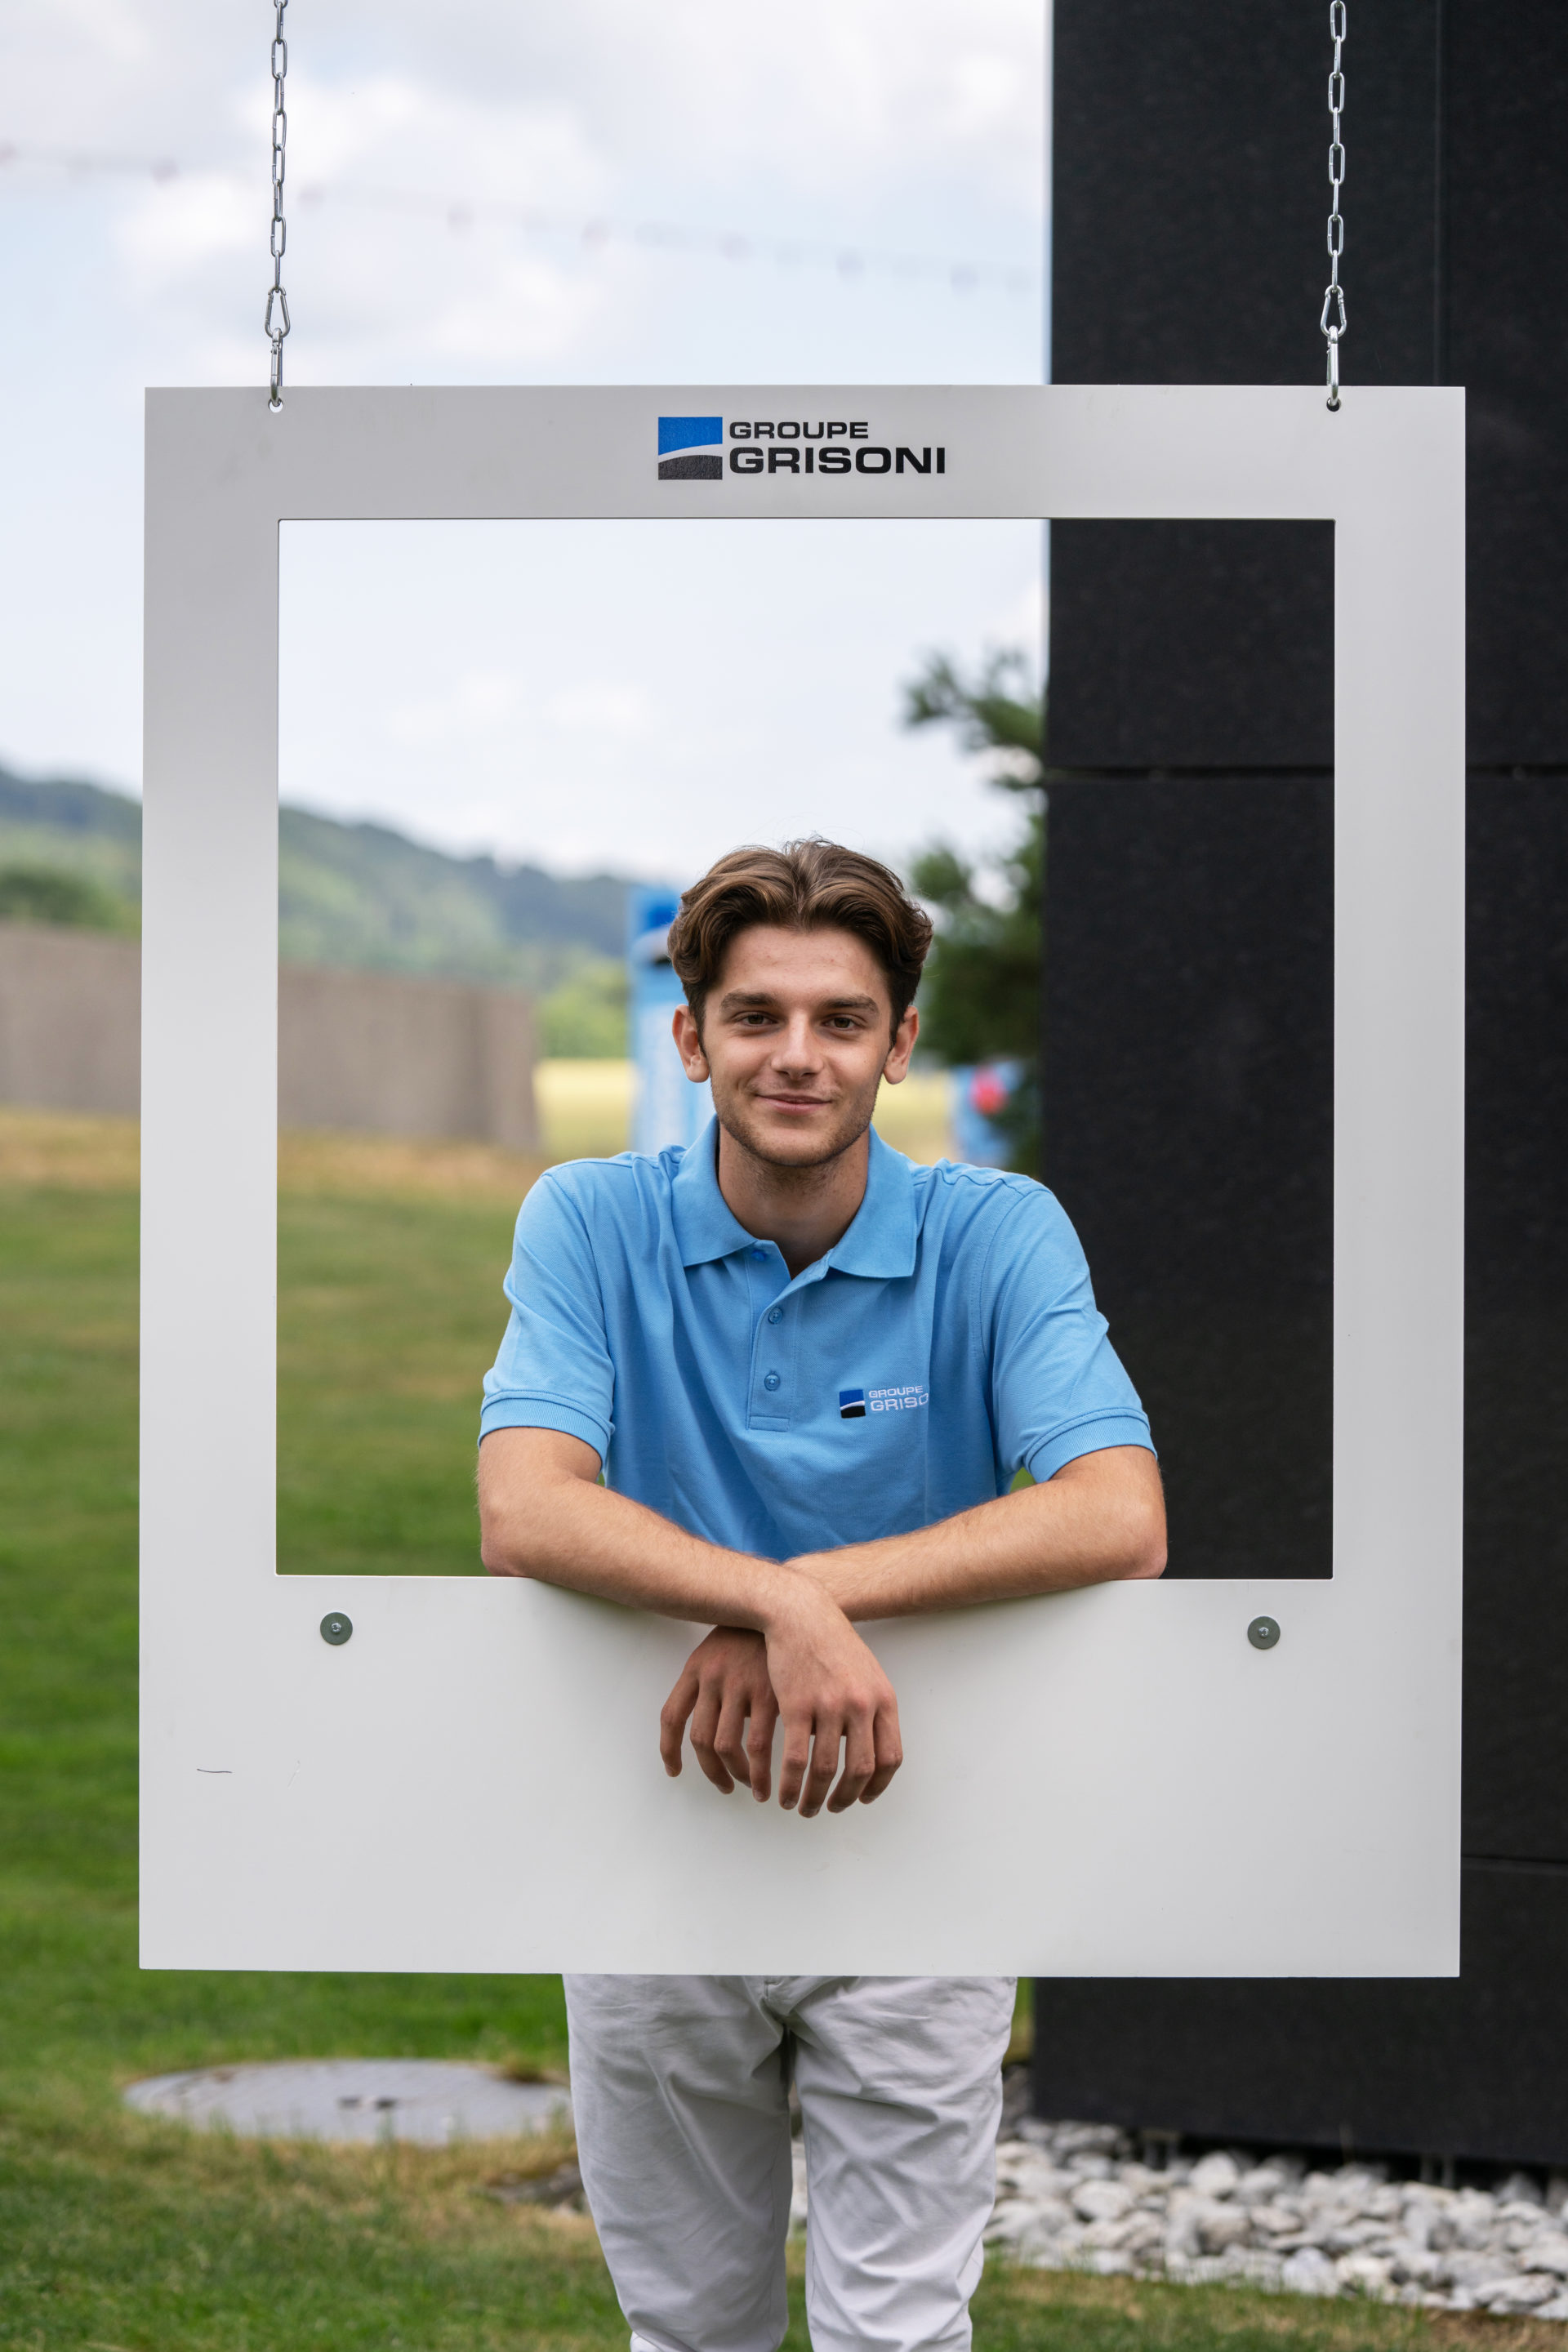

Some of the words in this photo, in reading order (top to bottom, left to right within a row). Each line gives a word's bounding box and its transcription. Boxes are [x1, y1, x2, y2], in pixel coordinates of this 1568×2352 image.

[729, 421, 869, 439] GROUPE
[729, 447, 946, 474] GRISONI
[869, 1386, 923, 1398] GROUPE
